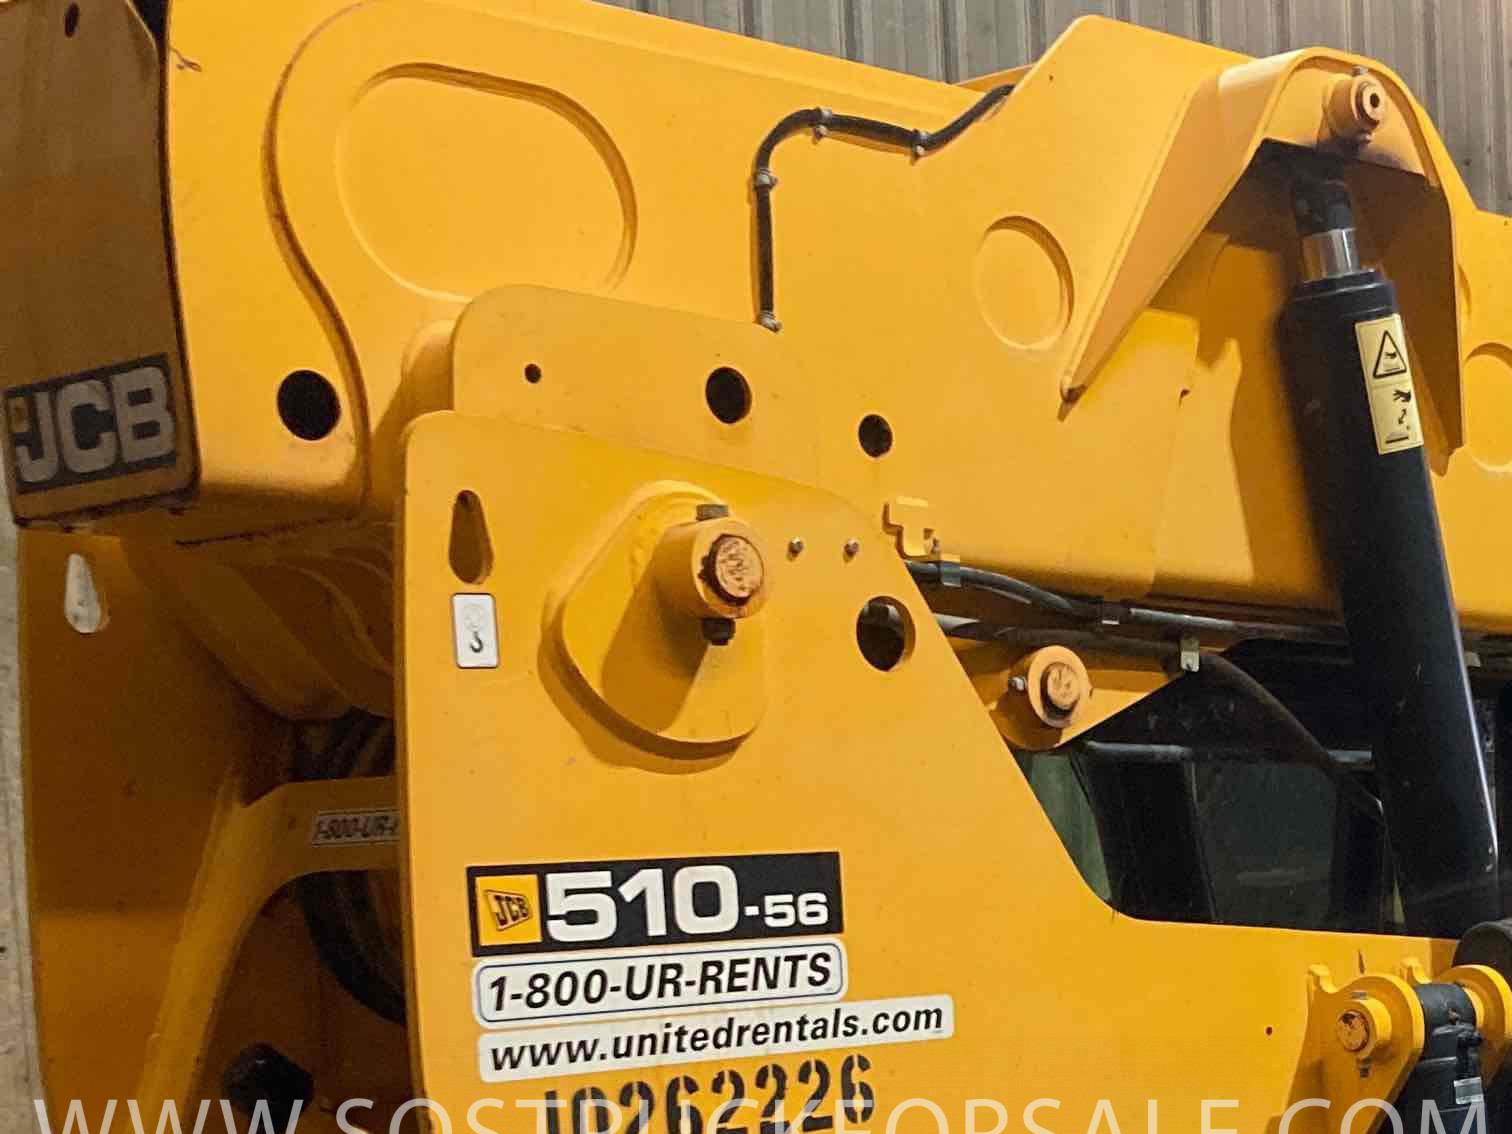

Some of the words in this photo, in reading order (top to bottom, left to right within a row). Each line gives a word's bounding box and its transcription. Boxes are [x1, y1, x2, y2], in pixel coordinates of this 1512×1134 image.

[16, 366, 176, 483] JCB
[491, 890, 530, 928] JCB
[543, 864, 829, 943] 510-56
[489, 951, 832, 1012] 1-800-UR-RENTS
[490, 1006, 944, 1072] www.unitedrentals.com
